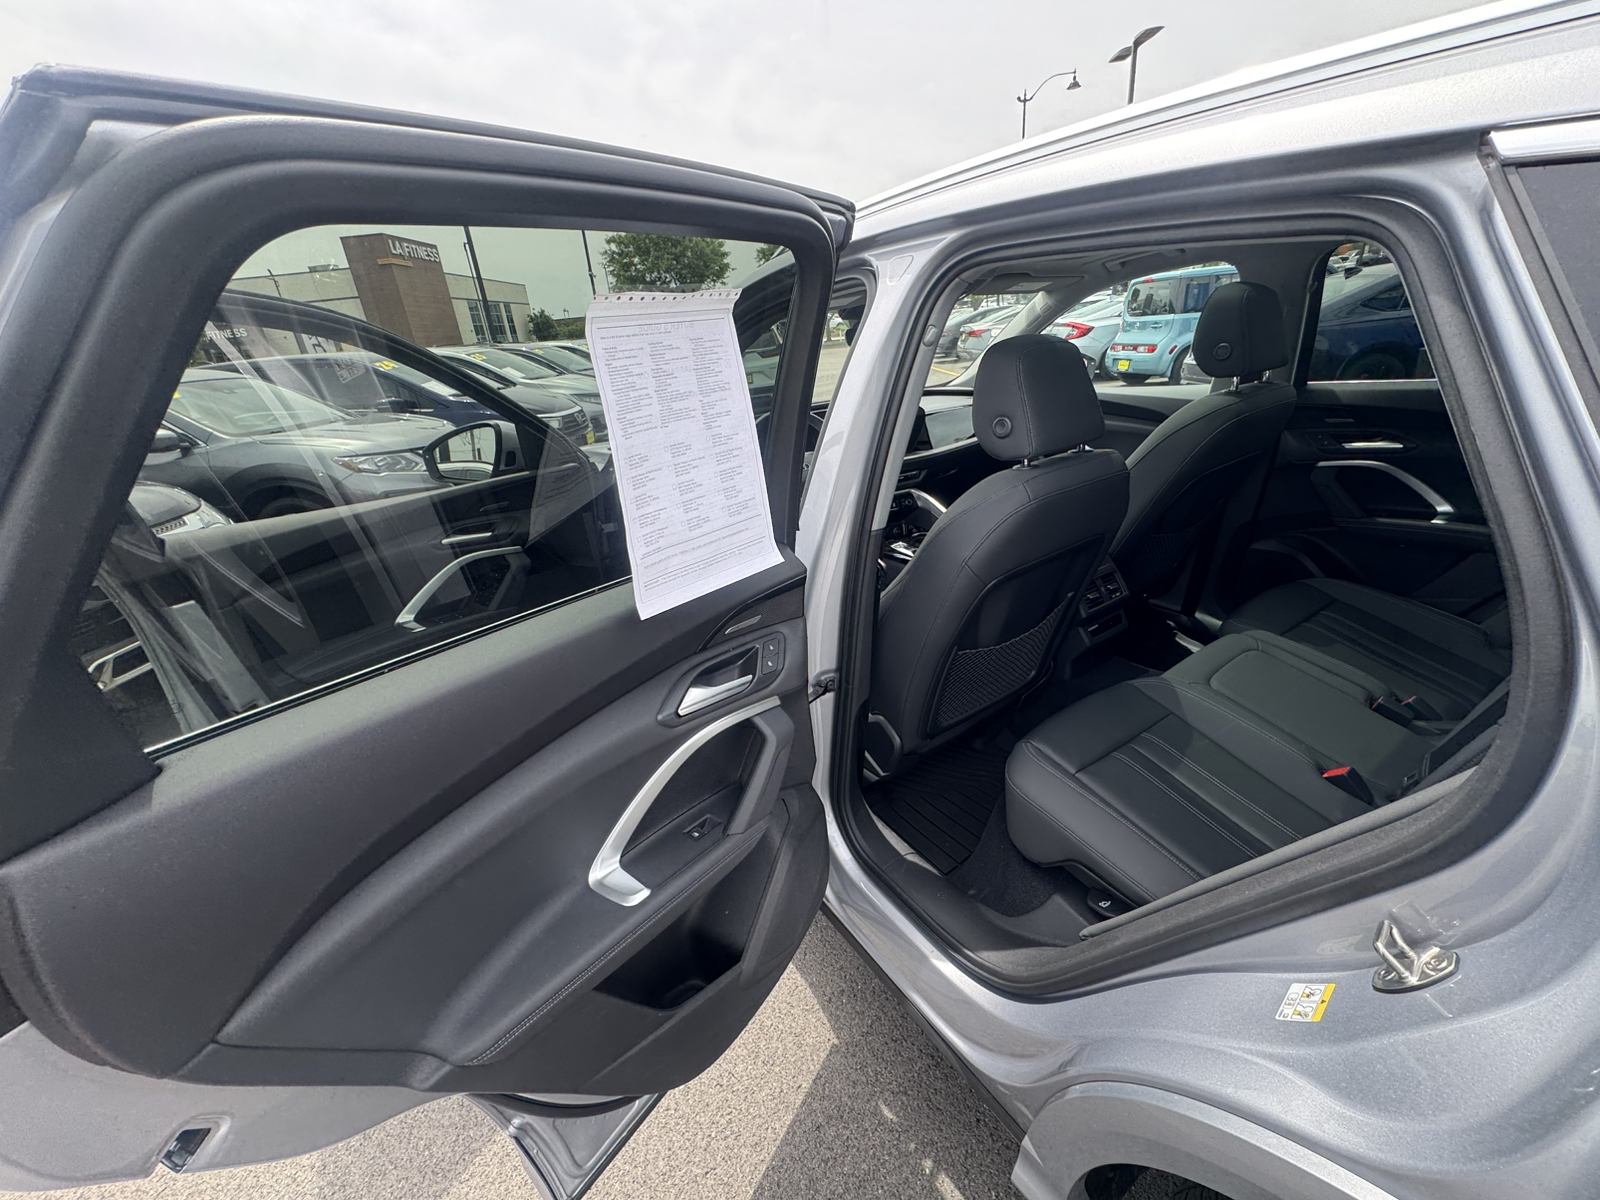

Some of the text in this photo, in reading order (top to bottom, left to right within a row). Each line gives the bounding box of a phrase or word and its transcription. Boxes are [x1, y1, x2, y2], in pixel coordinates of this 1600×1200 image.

[388, 239, 440, 262] LA FITNESS
[206, 327, 248, 341] FITNESS
